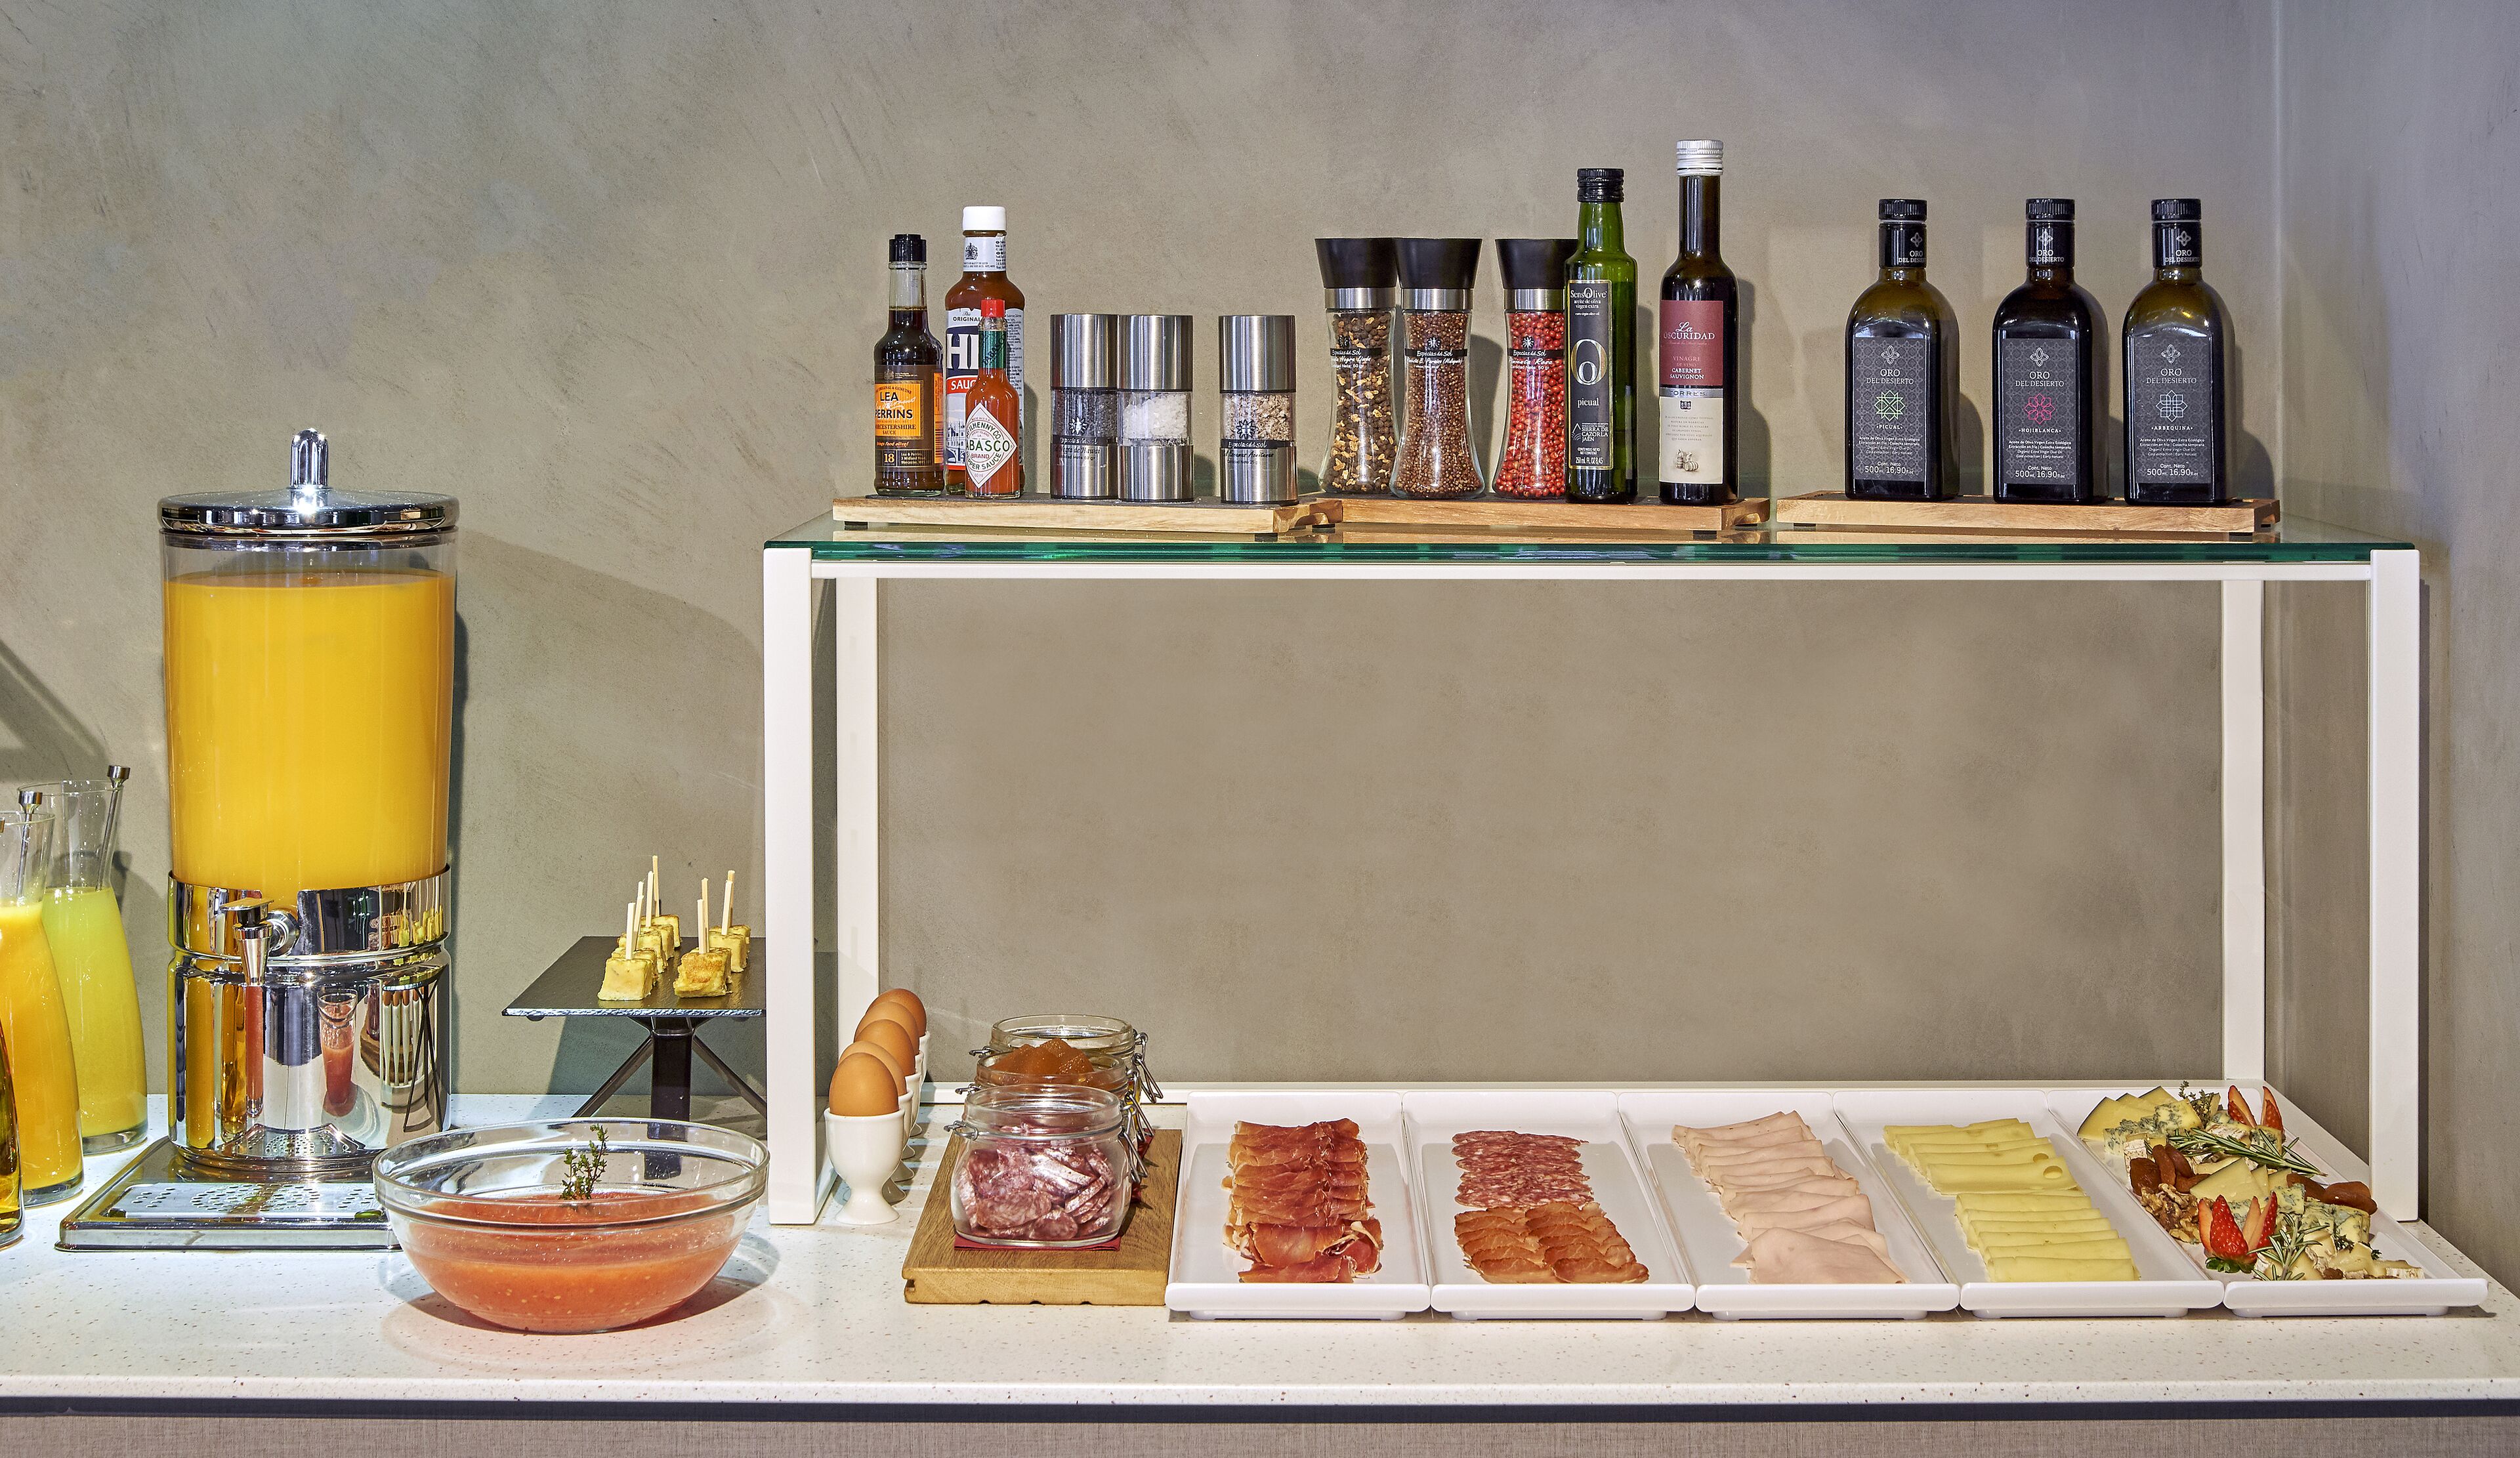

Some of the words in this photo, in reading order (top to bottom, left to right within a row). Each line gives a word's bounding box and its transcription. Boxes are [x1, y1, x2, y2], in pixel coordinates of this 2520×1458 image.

[1675, 322, 1693, 333] La
[951, 380, 977, 390] SAUC
[880, 392, 899, 402] LEA
[1577, 397, 1599, 408] picual
[966, 440, 1011, 452] ABASCO
[883, 453, 895, 463] 18
[982, 452, 1001, 470] SAUCE
